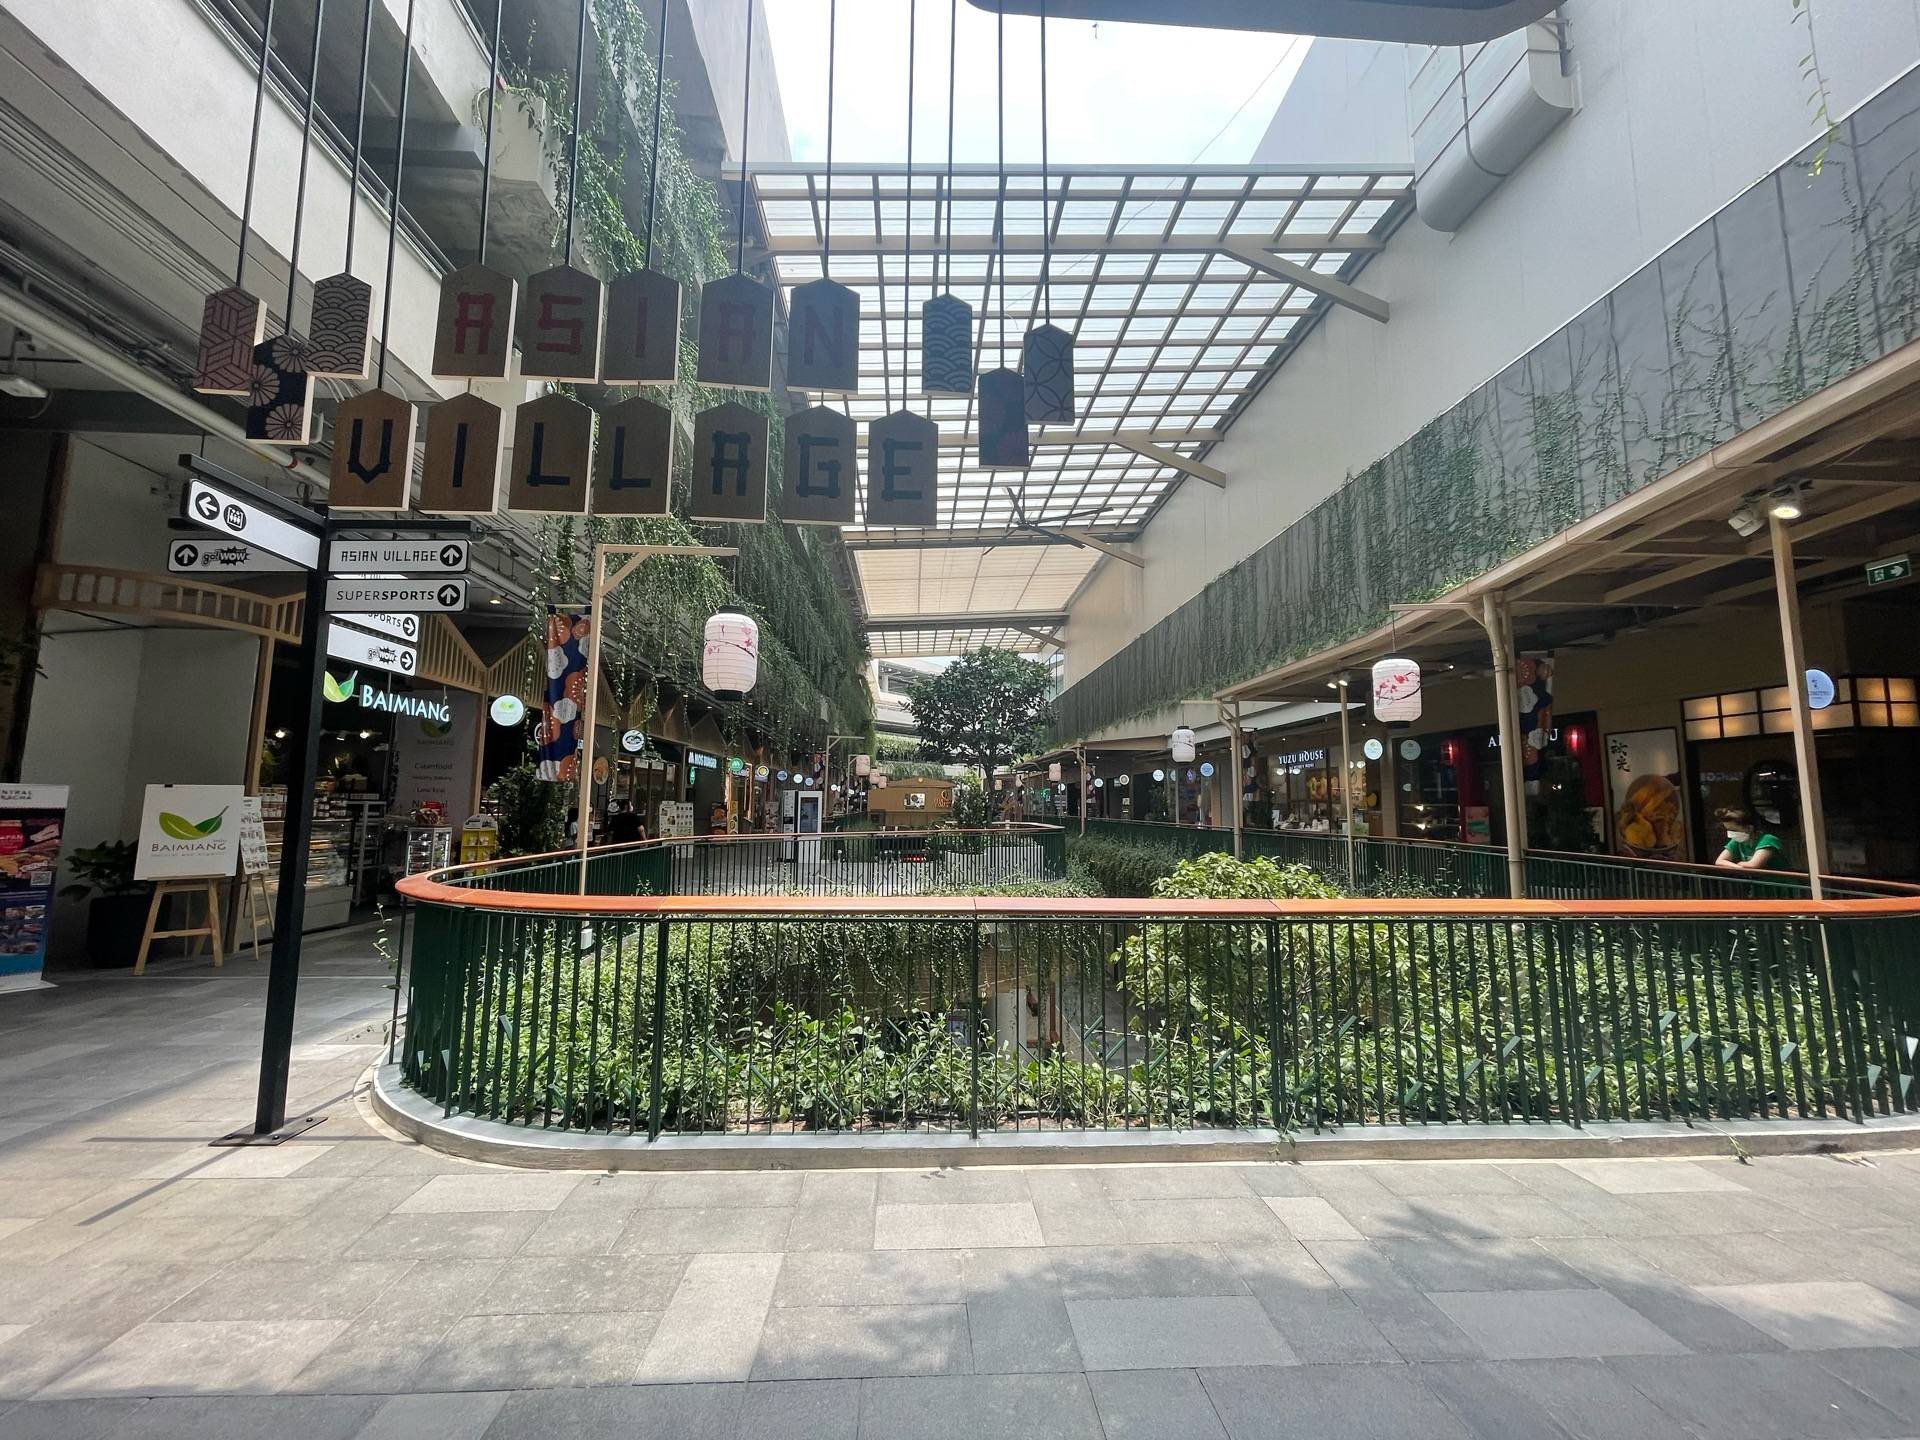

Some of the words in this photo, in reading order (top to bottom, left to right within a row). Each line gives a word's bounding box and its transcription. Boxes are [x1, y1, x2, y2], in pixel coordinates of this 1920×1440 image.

[454, 292, 844, 366] ASIAN
[347, 418, 924, 500] VILLAGE
[341, 550, 378, 562] ASIAN
[383, 550, 438, 562] VILLAGE
[336, 590, 435, 601] SUPERSPORTS
[362, 684, 450, 722] BAIMIANG
[1278, 754, 1297, 765] YUZU
[1299, 750, 1324, 763] HOUSE
[151, 843, 227, 852] BAIMIANG
